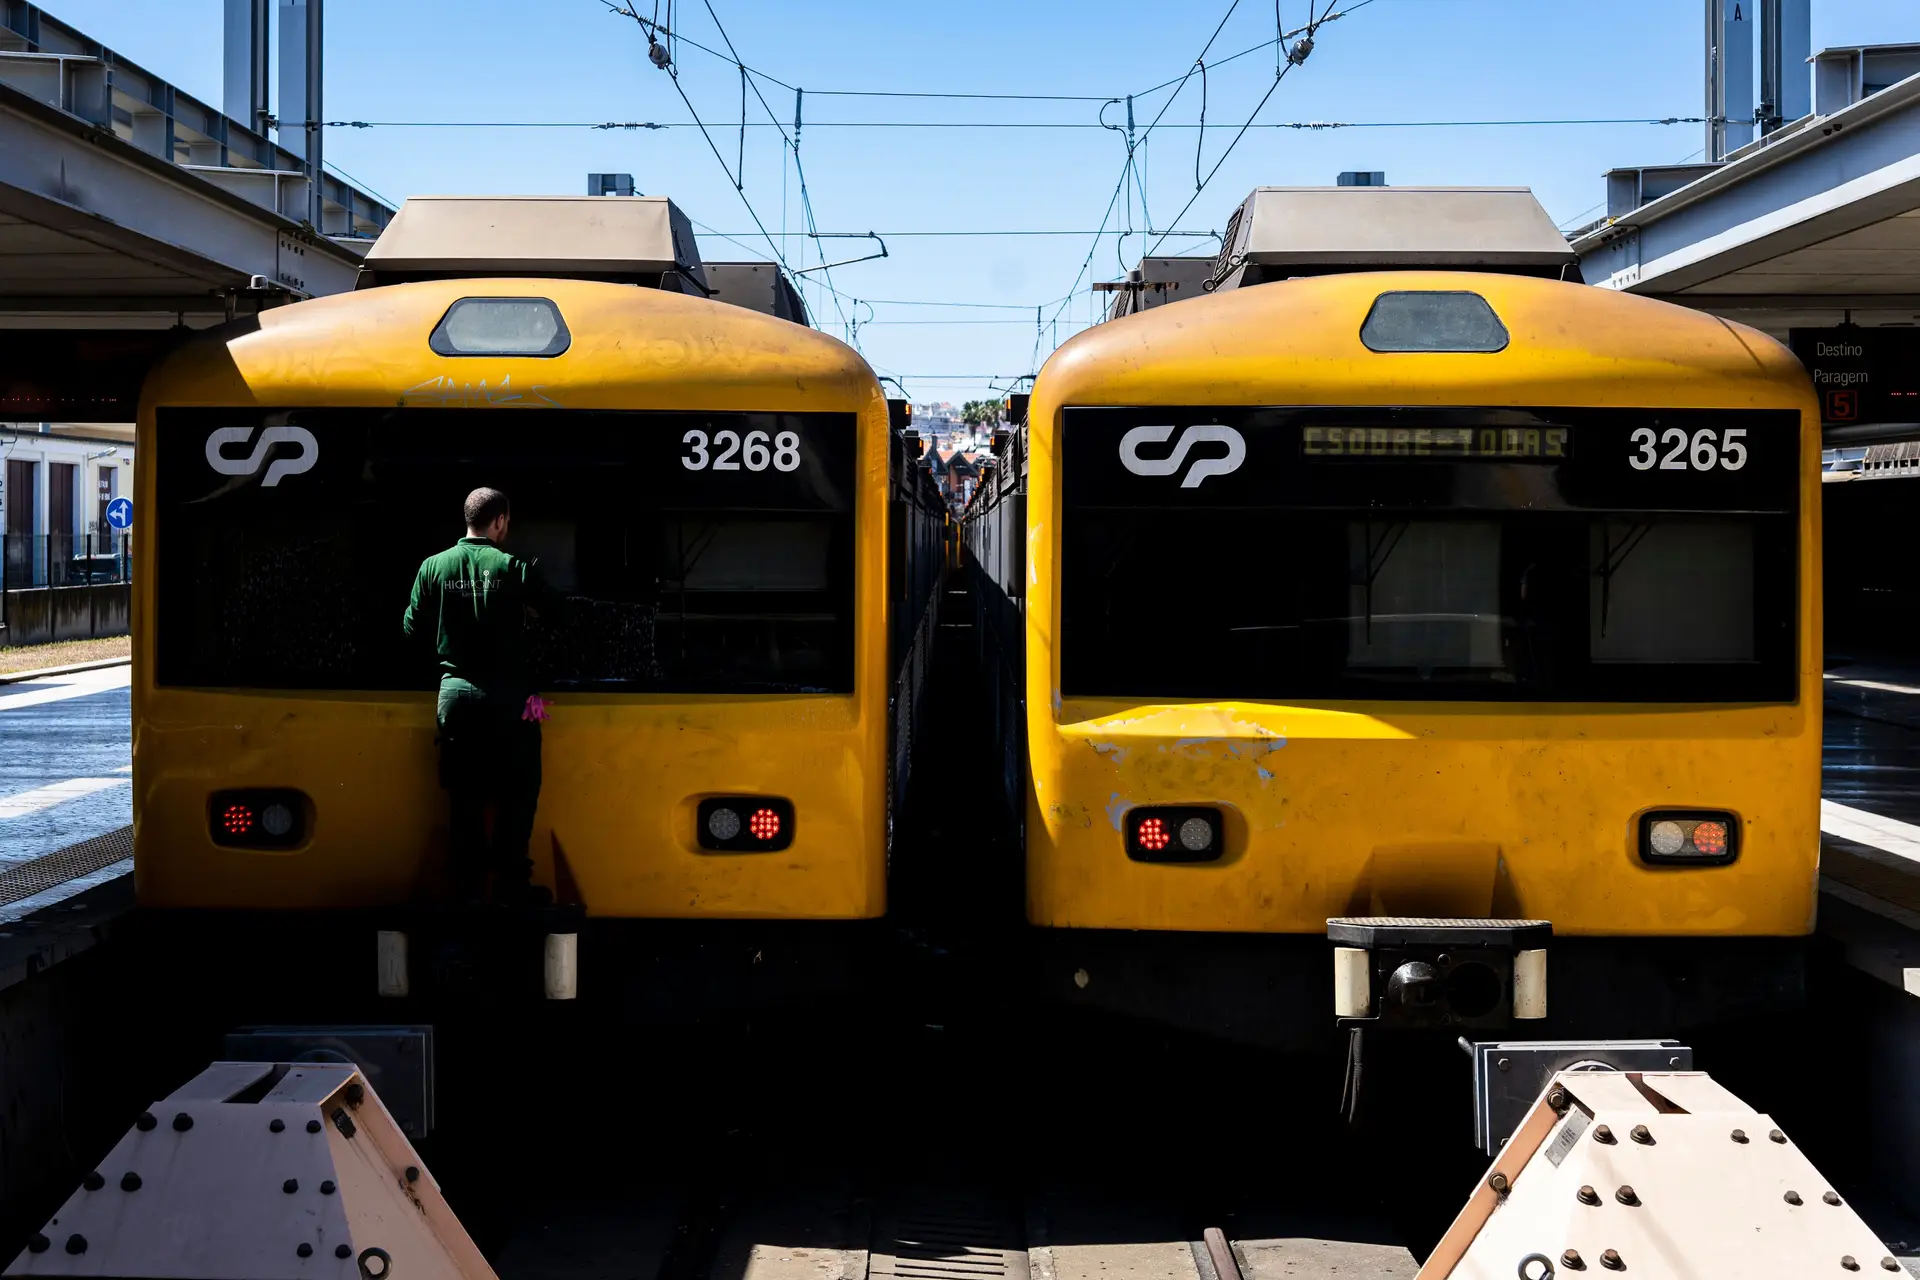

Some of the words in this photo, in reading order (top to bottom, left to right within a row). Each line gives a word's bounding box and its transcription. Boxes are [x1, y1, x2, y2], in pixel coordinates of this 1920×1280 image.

[1817, 341, 1863, 357] Destino
[1814, 368, 1869, 386] Paragem
[1834, 393, 1851, 417] 5
[205, 426, 319, 487] CP
[681, 429, 801, 472] 3268
[1118, 424, 1247, 488] CP
[1628, 427, 1748, 471] 3265
